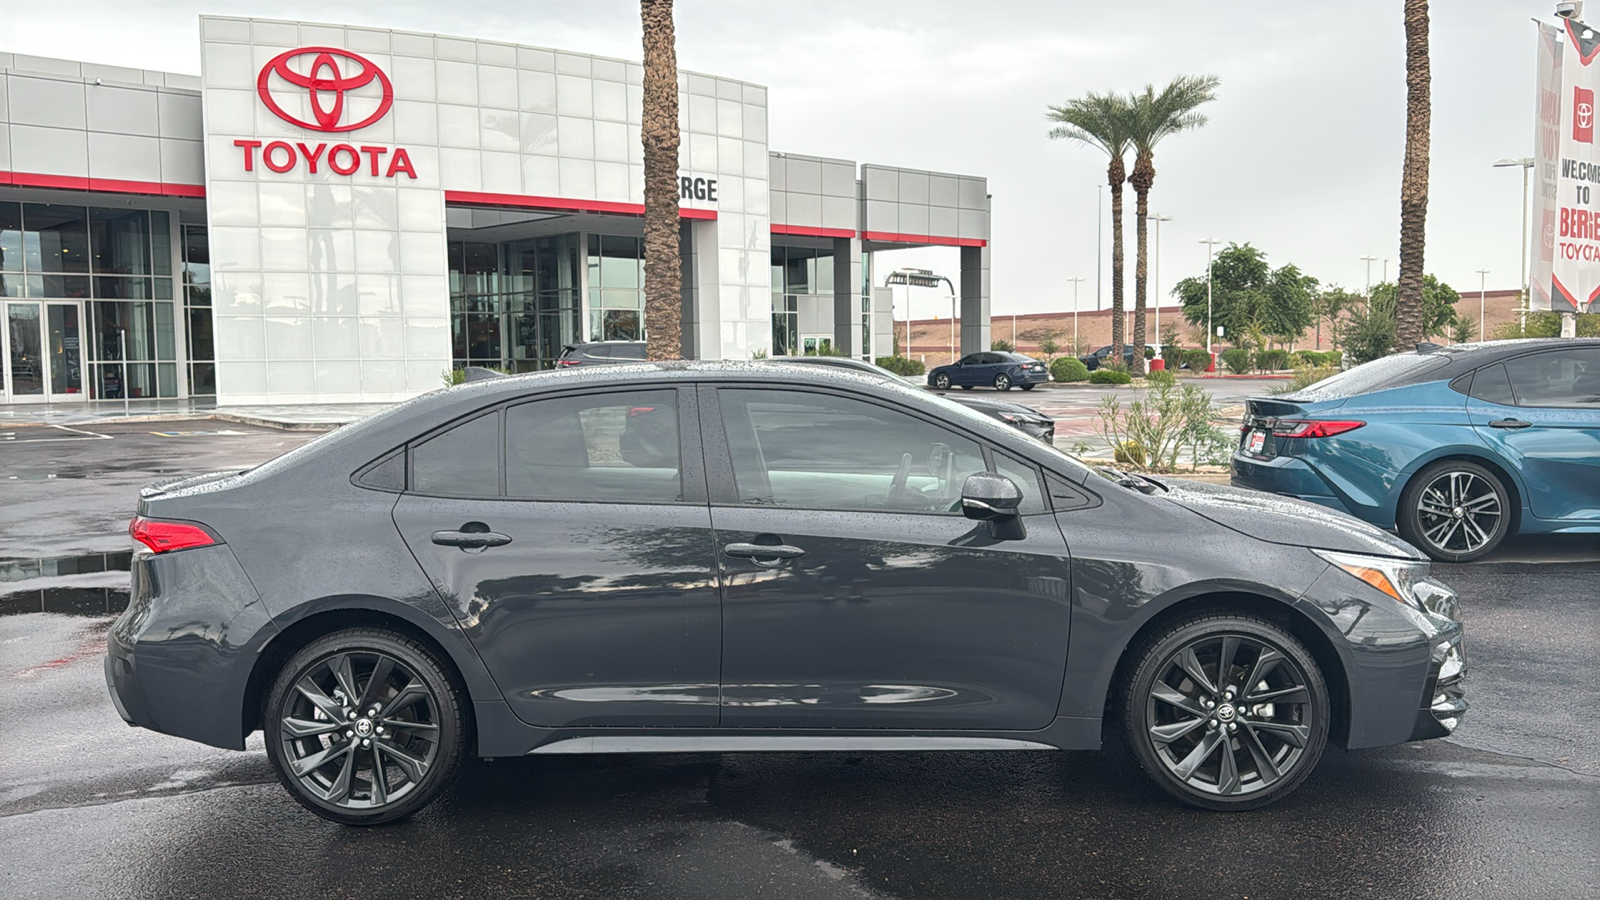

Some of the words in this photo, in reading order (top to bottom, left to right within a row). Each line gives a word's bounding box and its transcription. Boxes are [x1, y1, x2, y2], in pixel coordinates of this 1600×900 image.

[233, 140, 418, 179] TOYOTA
[1561, 158, 1600, 184] WECOME
[681, 176, 718, 202] RGE
[1576, 185, 1590, 204] TO
[1559, 207, 1600, 240] BERGE
[1559, 242, 1600, 262] TOYOTA
